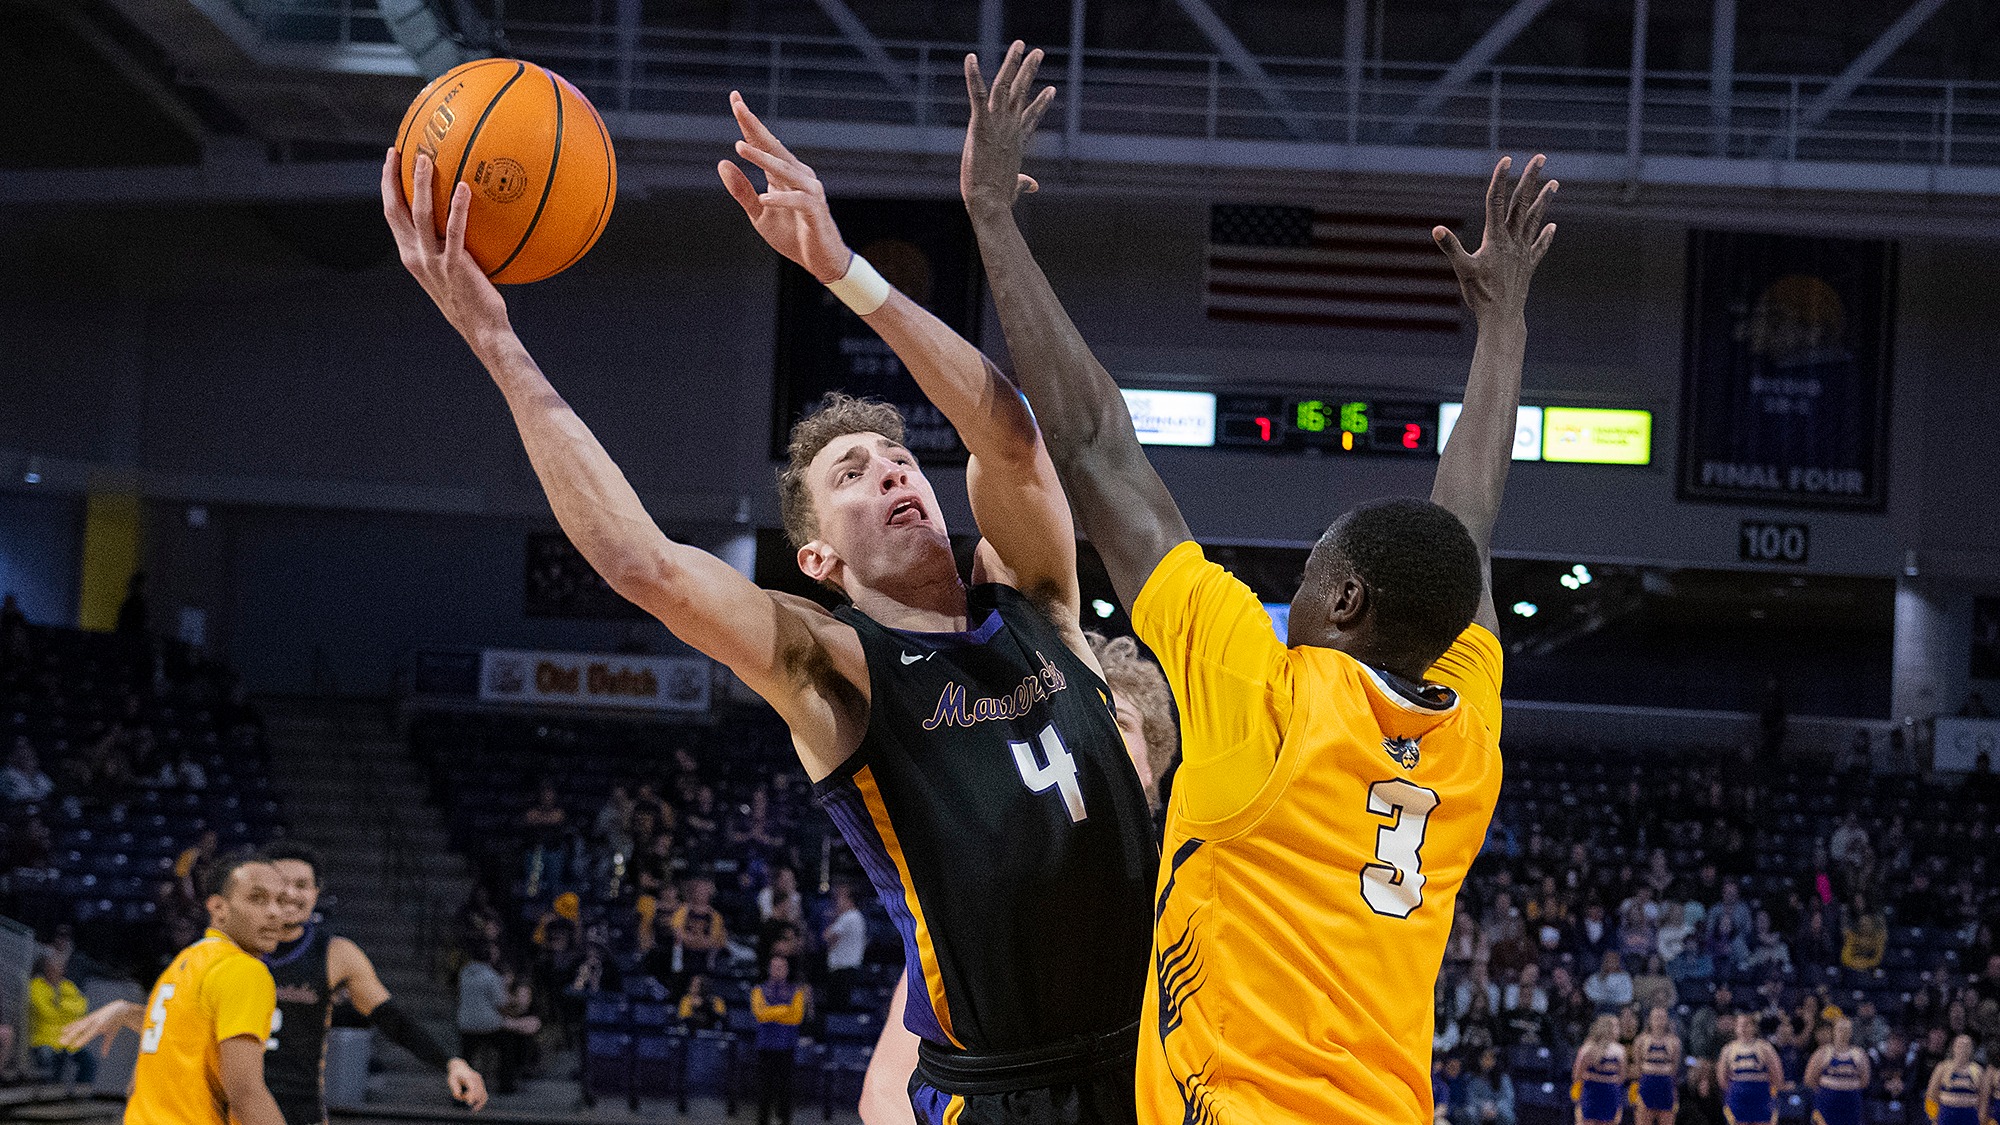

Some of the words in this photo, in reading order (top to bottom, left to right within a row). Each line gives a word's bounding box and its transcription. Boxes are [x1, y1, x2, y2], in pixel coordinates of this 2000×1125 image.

[416, 103, 456, 166] VO
[1254, 416, 1272, 442] 7
[1402, 423, 1421, 449] 2
[1702, 463, 1780, 489] FINAL
[1787, 466, 1864, 493] FOUR
[1745, 525, 1805, 560] 100
[1007, 719, 1090, 827] 4
[1359, 776, 1441, 920] 3
[141, 984, 175, 1053] 5
